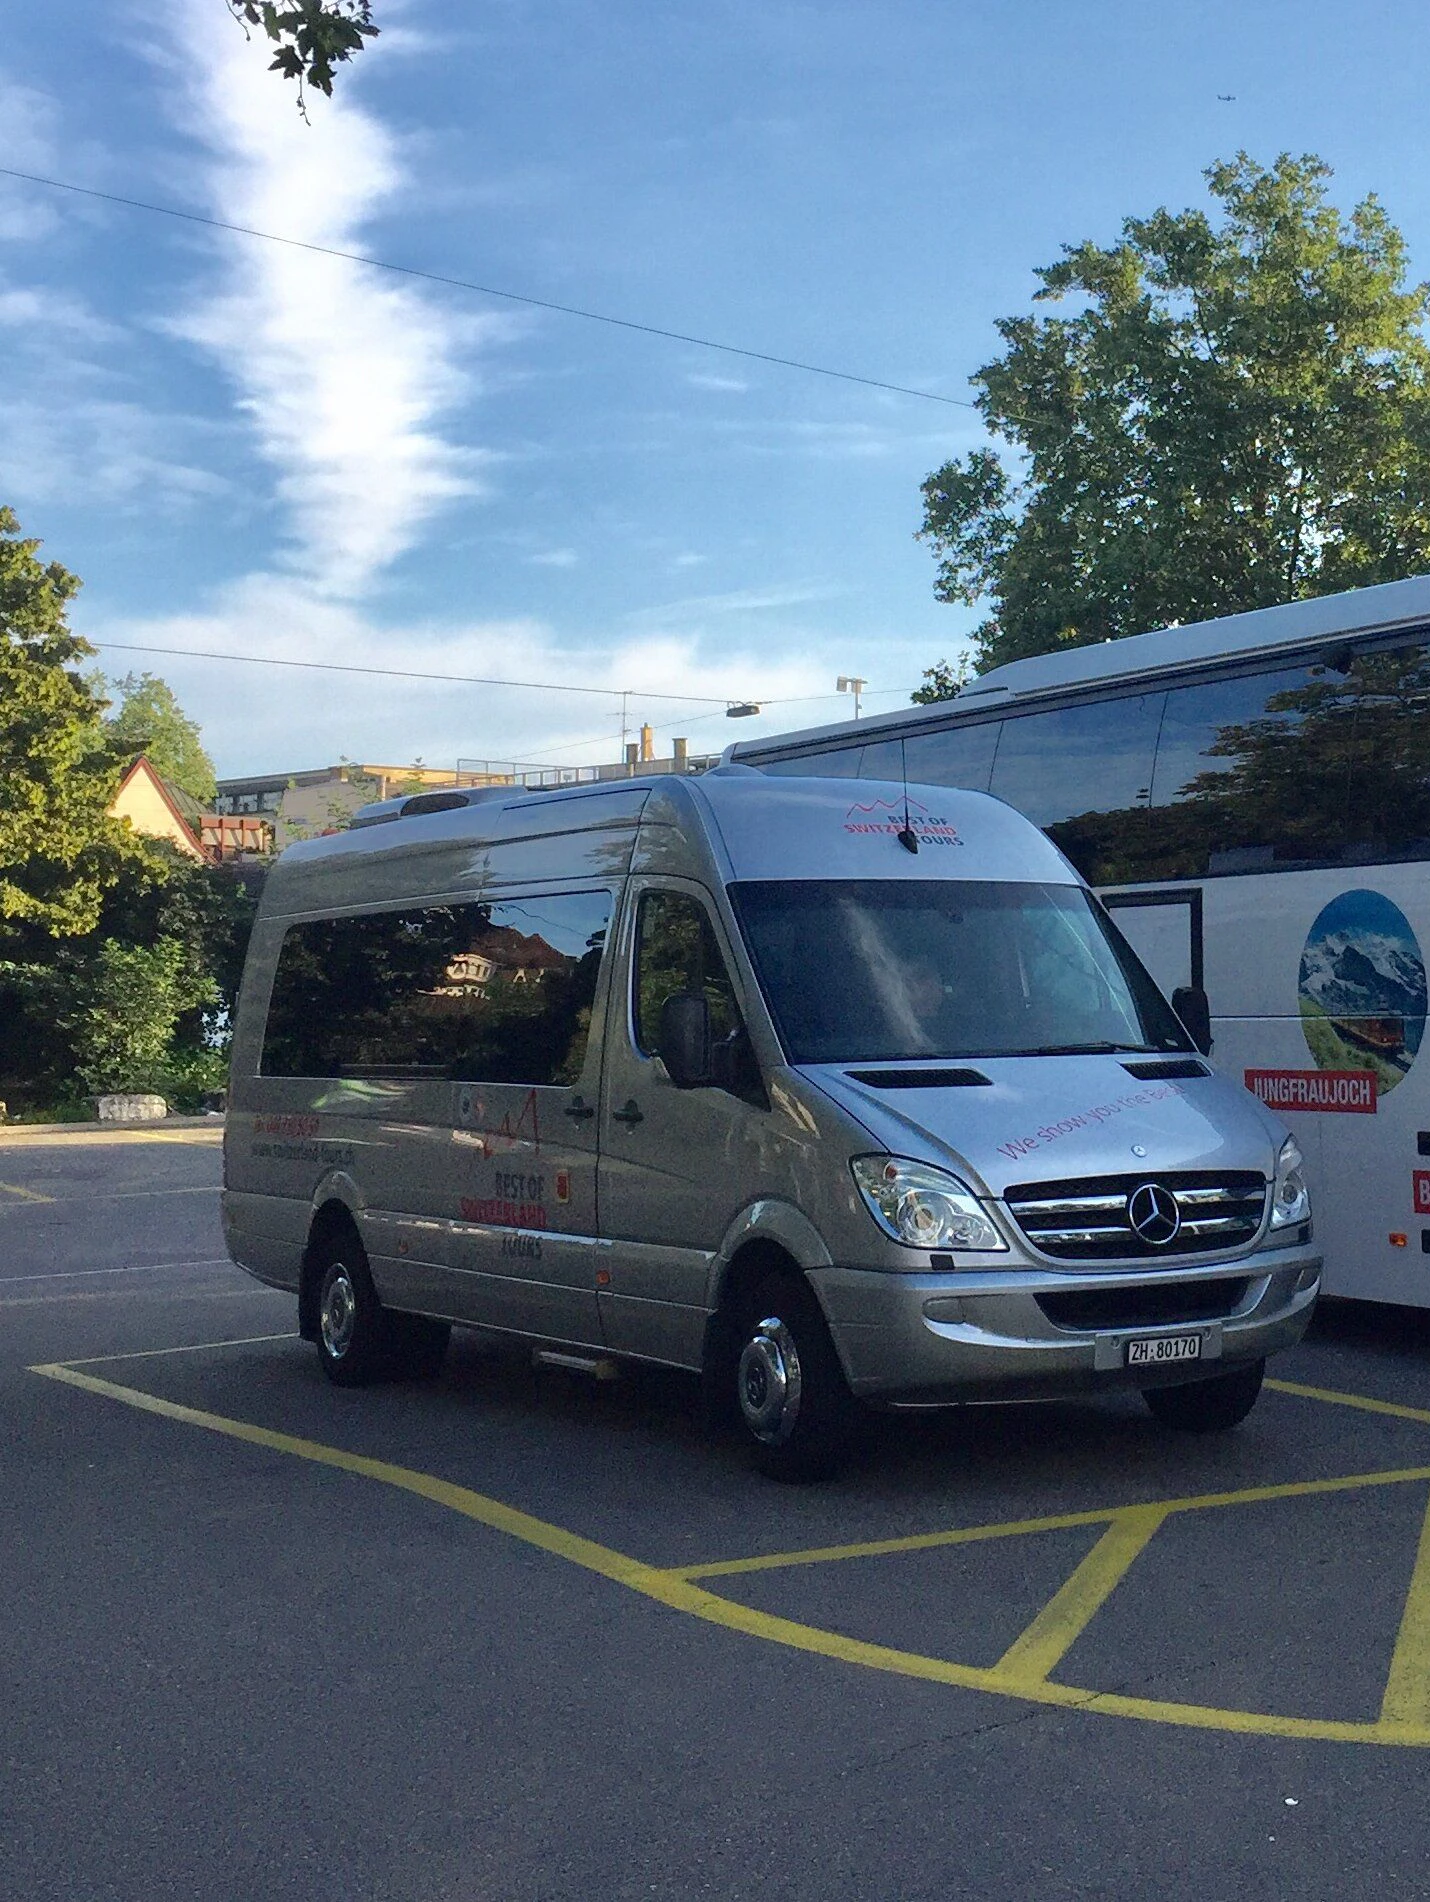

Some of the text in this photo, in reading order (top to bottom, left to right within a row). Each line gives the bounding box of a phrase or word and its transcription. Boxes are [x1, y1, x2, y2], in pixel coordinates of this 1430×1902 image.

[887, 815, 948, 826] BEST OF
[1253, 1077, 1371, 1105] JUNGFRAUJOCH
[997, 1138, 1040, 1161] We
[1037, 1115, 1087, 1142] show
[1087, 1103, 1122, 1124] you
